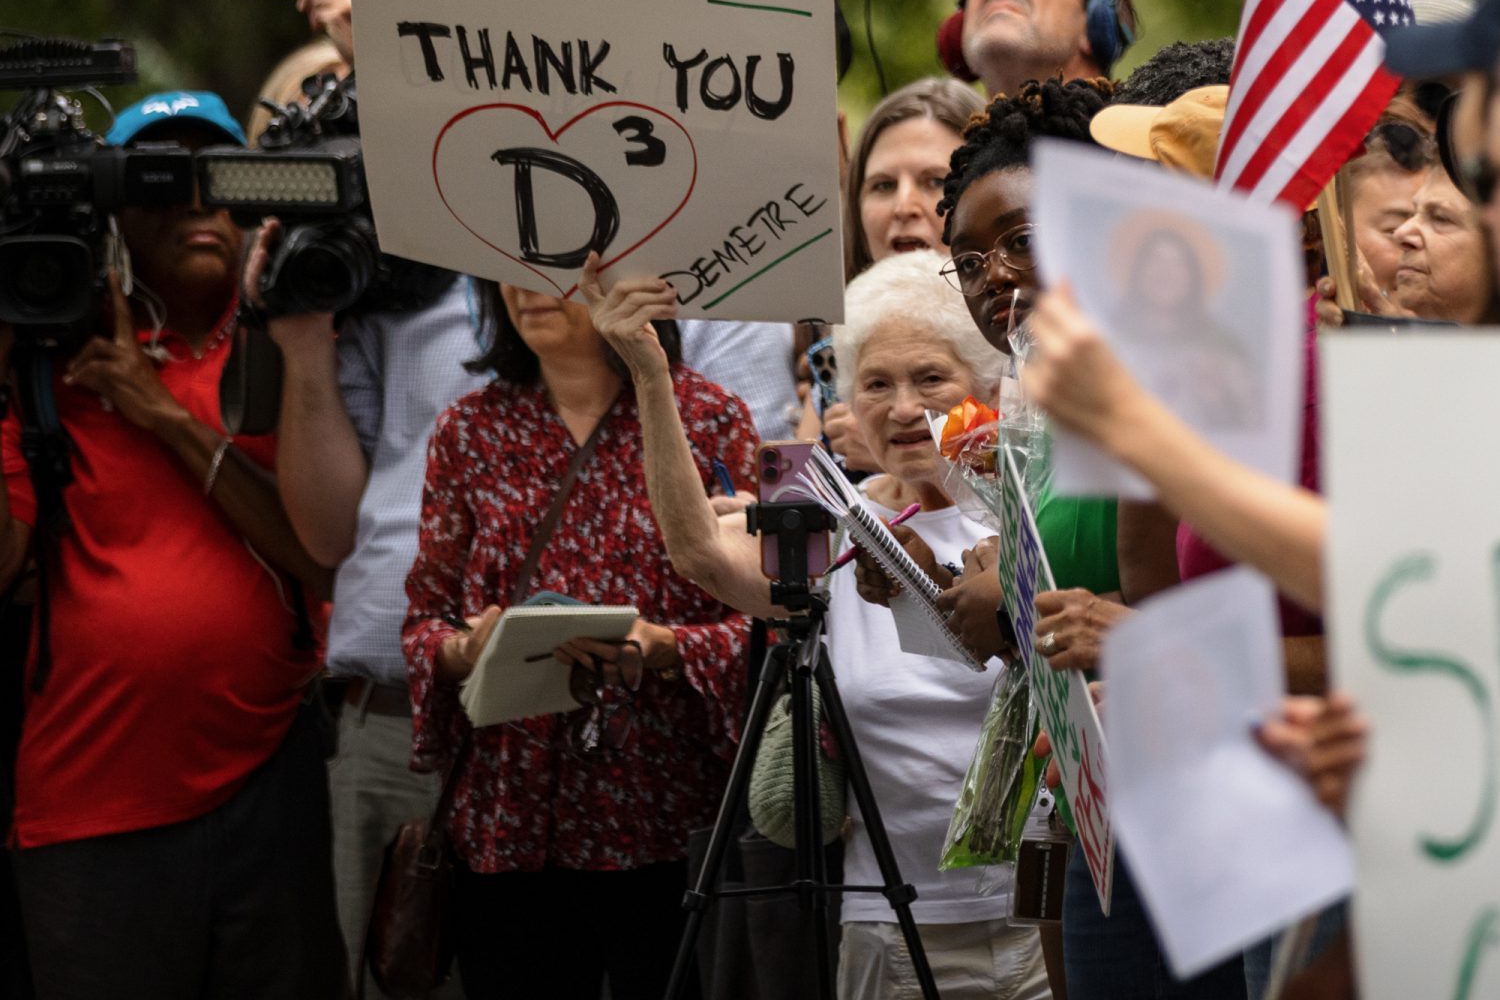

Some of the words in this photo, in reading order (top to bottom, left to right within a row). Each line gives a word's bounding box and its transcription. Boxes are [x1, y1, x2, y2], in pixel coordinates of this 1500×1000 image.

[397, 22, 617, 96] THANK
[663, 42, 795, 120] YOU
[659, 183, 828, 306] DEMETRE
[1015, 503, 1039, 671] DANGER
[1075, 727, 1106, 891] RFK
